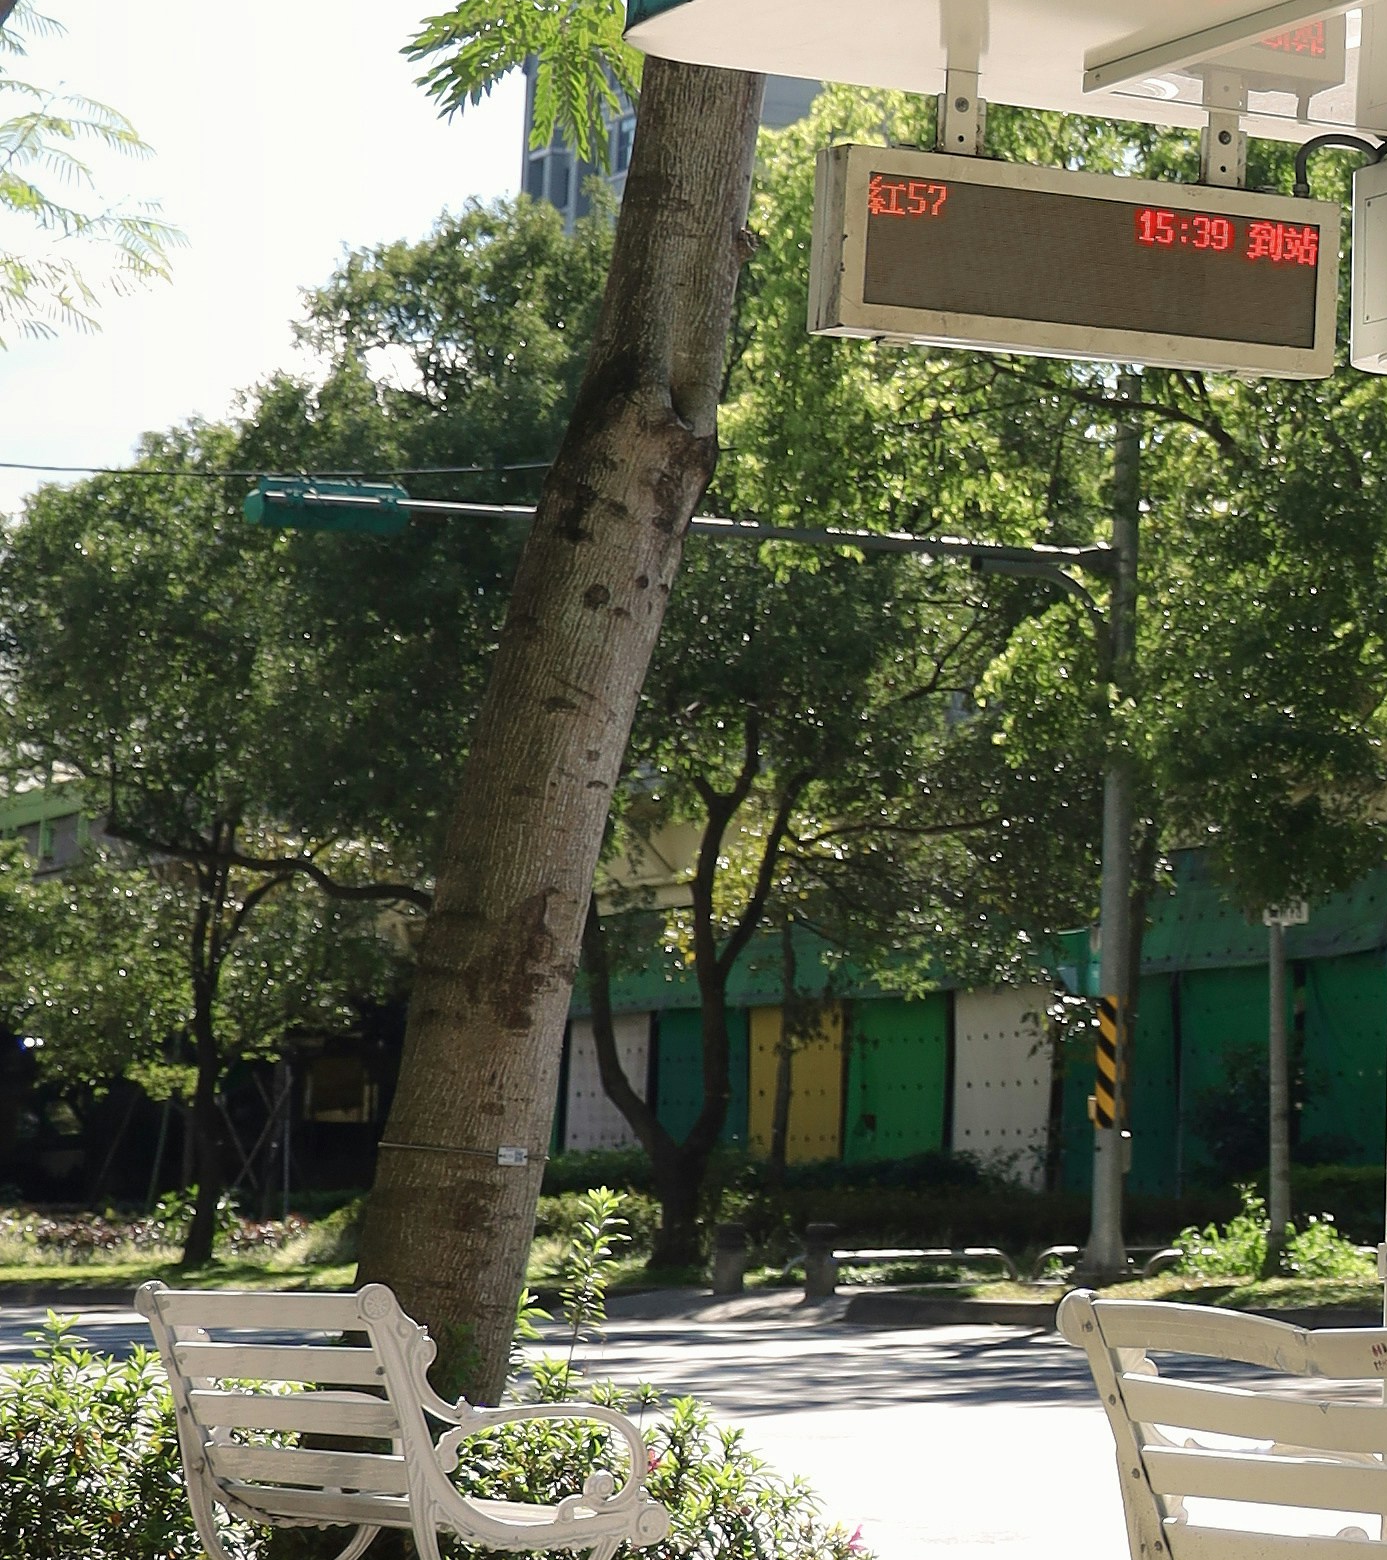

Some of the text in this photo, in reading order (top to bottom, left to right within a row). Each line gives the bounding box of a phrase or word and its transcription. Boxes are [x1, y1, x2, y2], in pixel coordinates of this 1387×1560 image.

[867, 175, 948, 217] 紅57
[1136, 208, 1318, 267] 15:39 到站
